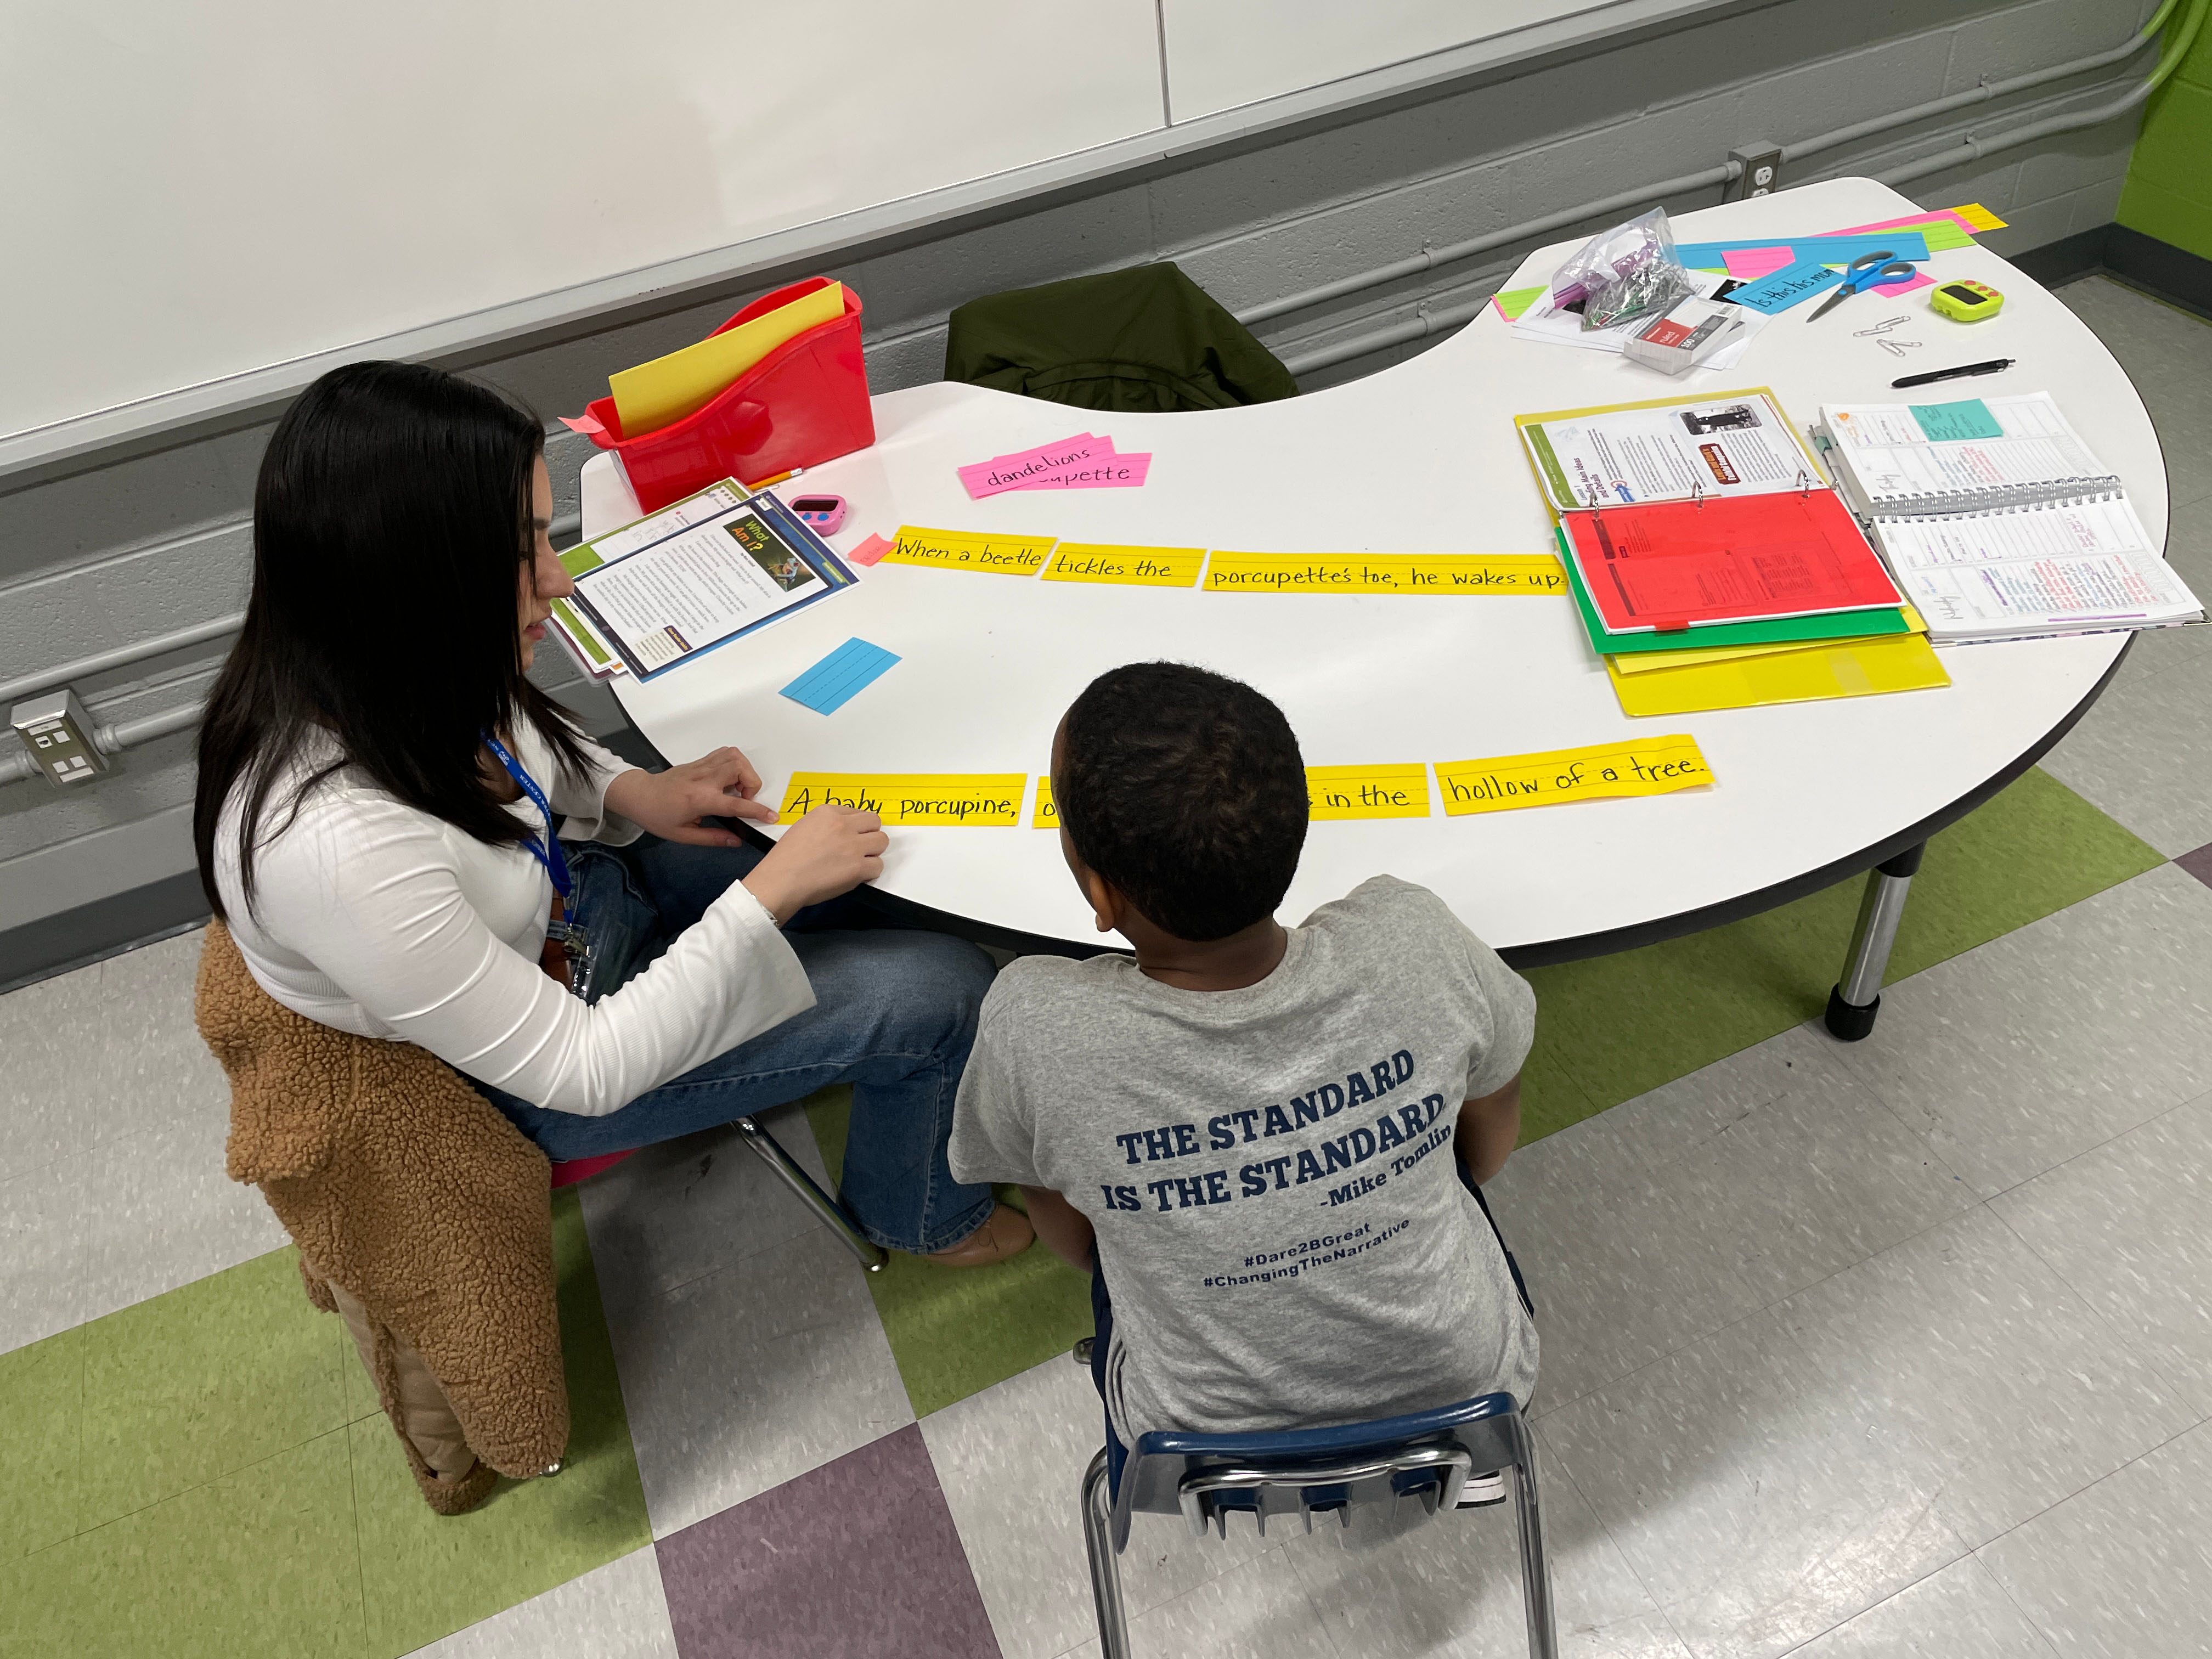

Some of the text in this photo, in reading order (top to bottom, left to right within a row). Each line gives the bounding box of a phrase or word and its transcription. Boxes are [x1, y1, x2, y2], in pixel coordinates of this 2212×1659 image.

[1744, 298, 1772, 308] Is
[1760, 286, 1796, 301] this
[1660, 330, 1676, 344] ruled
[1680, 338, 1695, 349] 100
[988, 449, 1090, 486] dandelions
[1573, 457, 1584, 471] Ideas
[1578, 471, 1590, 483] Main
[1590, 473, 1610, 498] and Details
[731, 527, 764, 551] Am I?
[745, 520, 770, 542] What
[896, 537, 949, 558] When
[958, 550, 970, 562] a
[979, 544, 1042, 566] beetle
[1055, 554, 1125, 575] tickles
[1133, 560, 1172, 577] the
[1212, 567, 1352, 589] porcupette's
[1363, 566, 1398, 588] toe,
[1412, 567, 1438, 585] he
[1451, 568, 1516, 585] wakes
[787, 787, 814, 816] A
[825, 787, 883, 814] baby
[900, 792, 1016, 821] porcupine,
[1322, 787, 1351, 808] in
[1357, 785, 1410, 806] the
[1447, 775, 1538, 802] hollow
[1555, 761, 1584, 790] of
[1600, 767, 1620, 782] a
[1630, 755, 1705, 782] tree.
[1116, 1048, 1415, 1164] THE STANDARD
[1100, 1092, 1447, 1212] IS THE STANDARD
[1320, 1124, 1452, 1207] -Mike Tomlin
[1203, 1219, 1410, 1288] #ChangingTheNarrative
[1244, 1222, 1372, 1268] #Dare2BGreat
